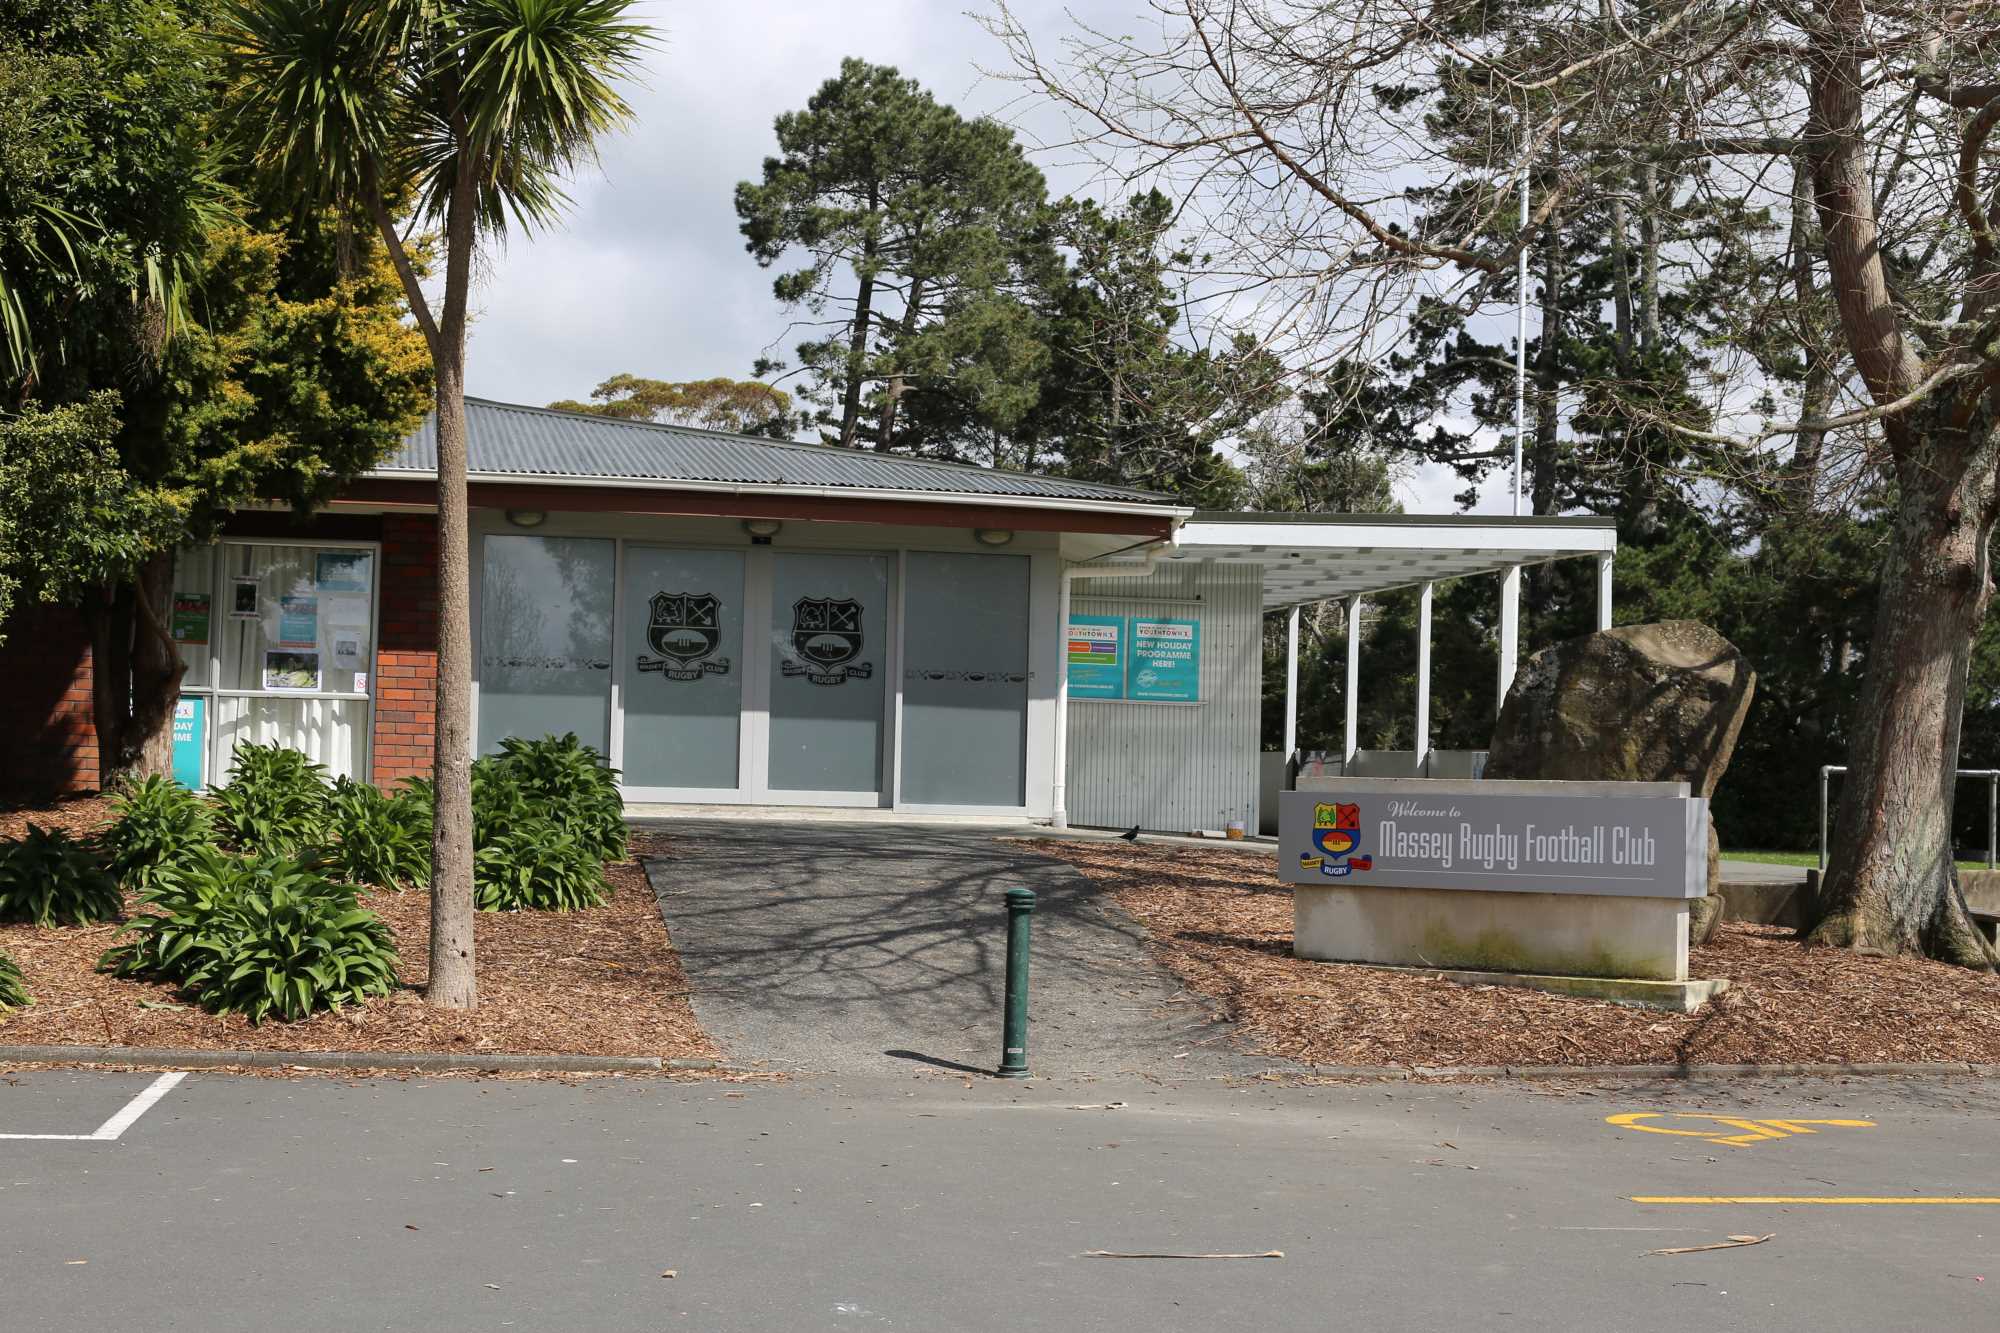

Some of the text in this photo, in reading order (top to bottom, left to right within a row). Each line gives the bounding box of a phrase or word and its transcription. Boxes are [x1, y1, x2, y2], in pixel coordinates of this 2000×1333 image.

[1136, 640, 1192, 650] NEW HOLIDAY
[1136, 649, 1192, 660] PROGRAMME
[1152, 659, 1176, 668] HERE!
[669, 670, 699, 680] RUGBY
[812, 675, 841, 684] RUGBY
[174, 721, 193, 731] DAY
[1387, 800, 1461, 817] Welcome to
[1380, 821, 1655, 870] Massey Rugby Football Club
[1324, 866, 1348, 876] RUGBY
